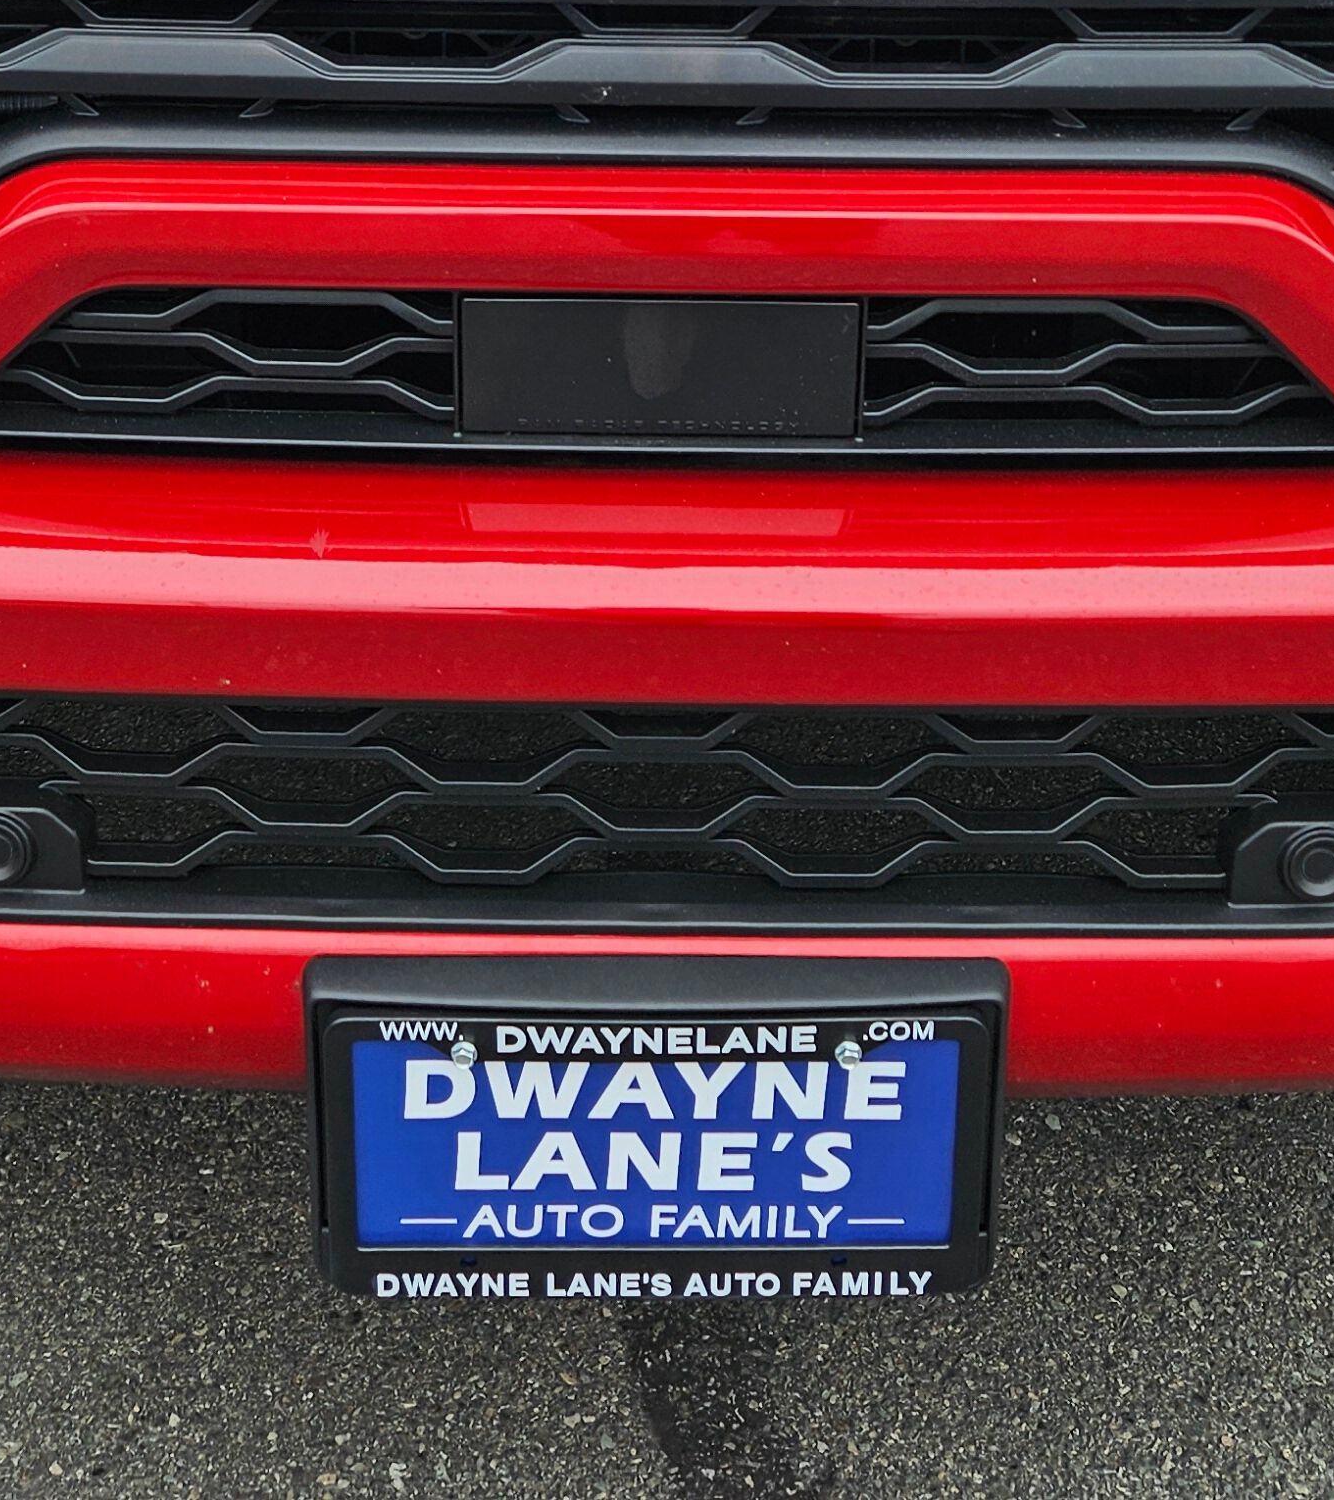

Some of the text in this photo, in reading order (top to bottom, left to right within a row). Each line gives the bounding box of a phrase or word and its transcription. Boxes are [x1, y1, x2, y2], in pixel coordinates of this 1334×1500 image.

[496, 1025, 817, 1055] DWAYNELANE
[862, 1021, 934, 1041] .COM
[403, 1060, 907, 1121] DWAYNE
[455, 1131, 853, 1193] LANE'S
[463, 1204, 843, 1239] AUTO FAMILY
[376, 1271, 932, 1298] DWAYNE LANE'S AUTO FAMILY
